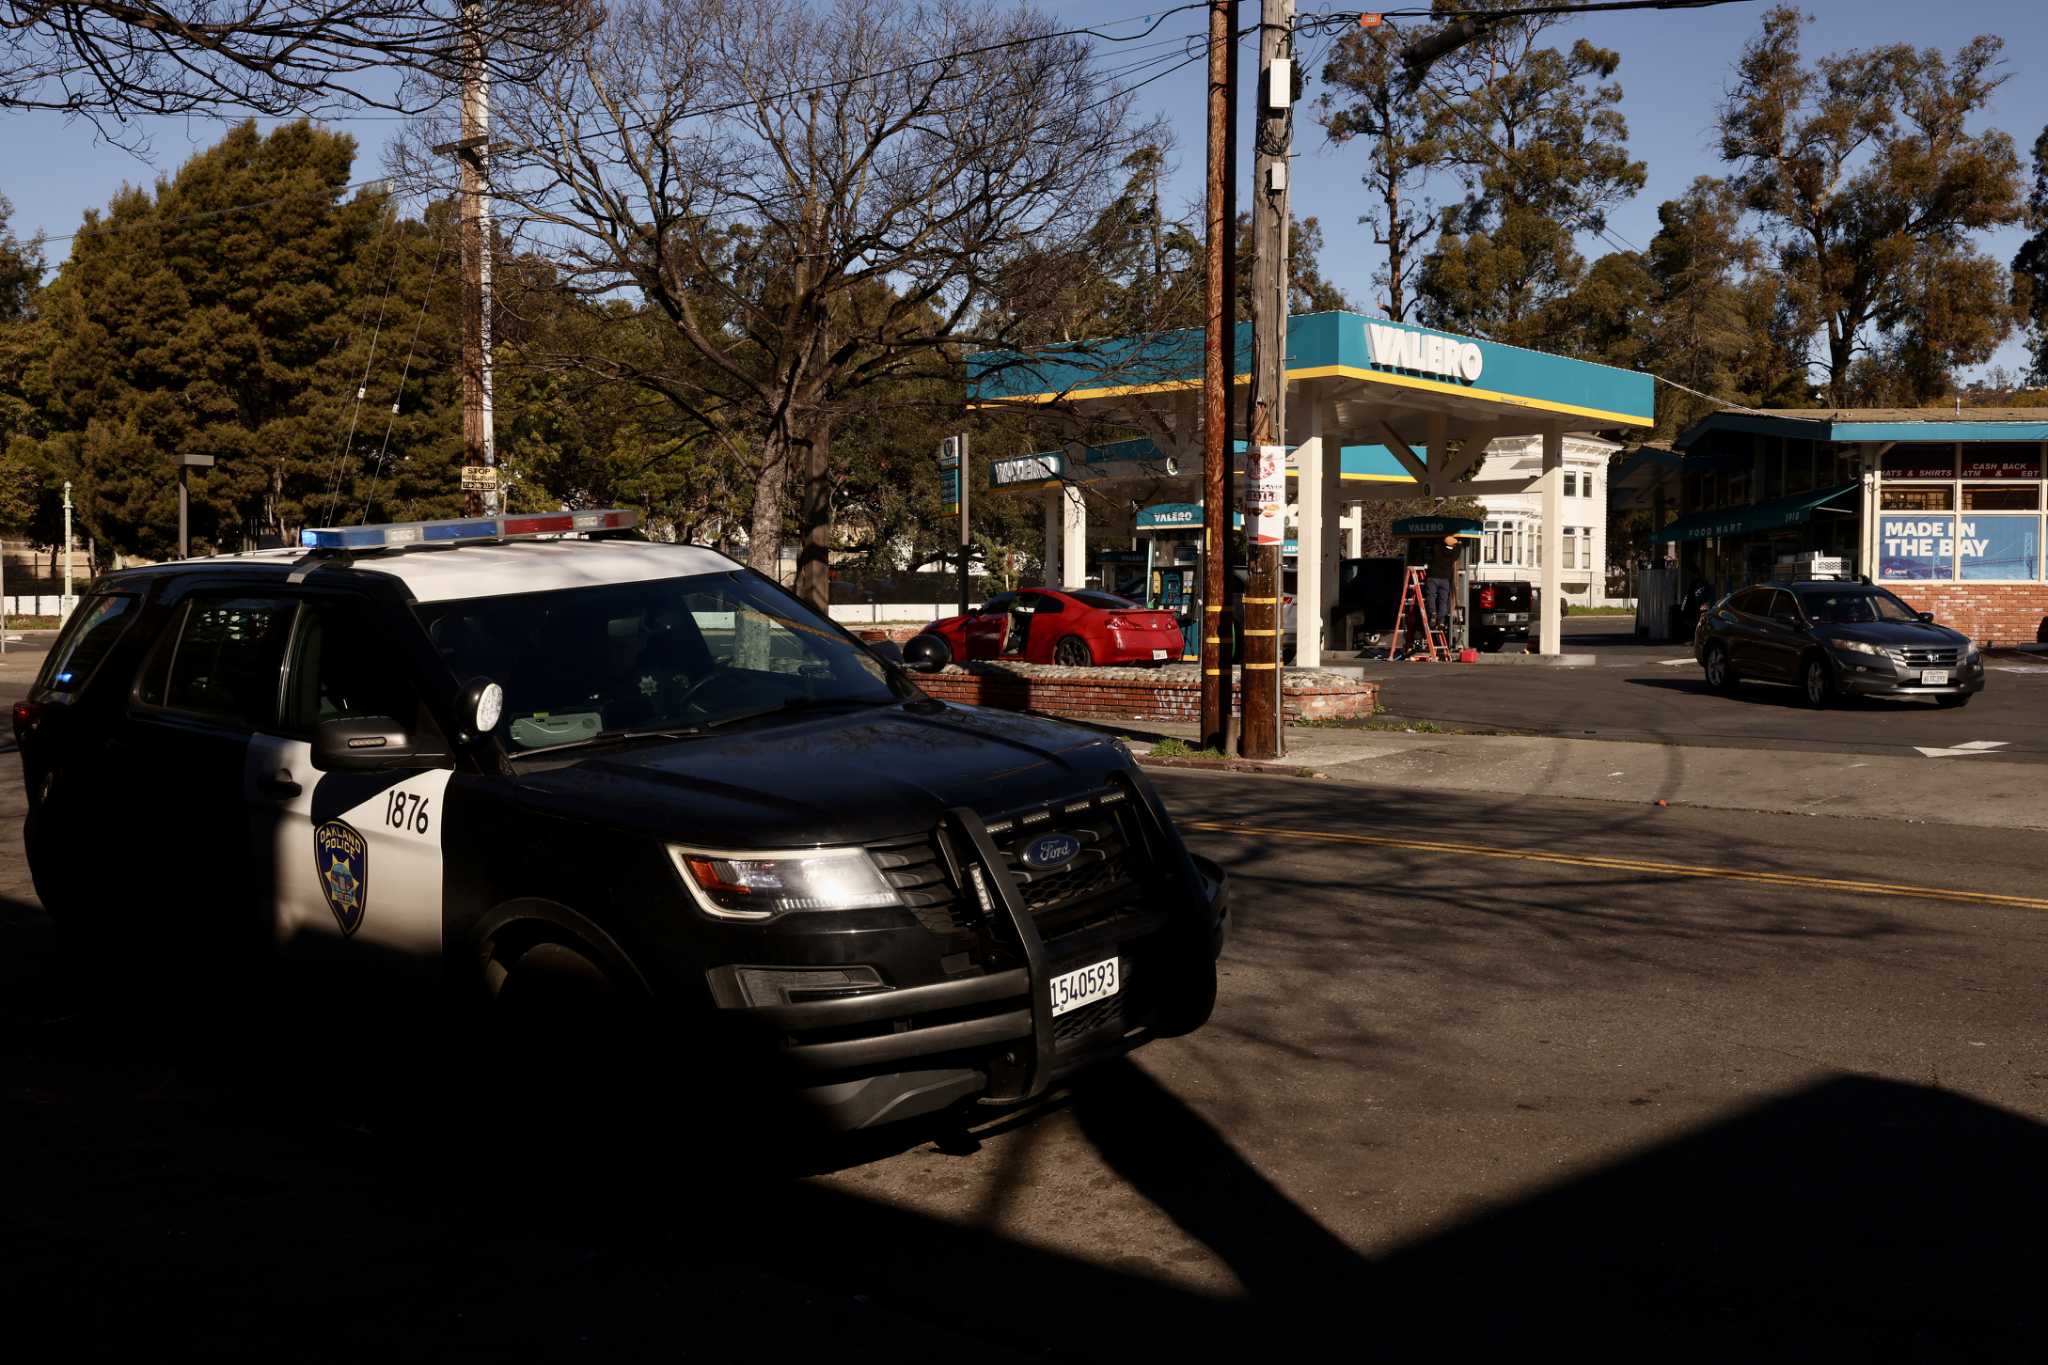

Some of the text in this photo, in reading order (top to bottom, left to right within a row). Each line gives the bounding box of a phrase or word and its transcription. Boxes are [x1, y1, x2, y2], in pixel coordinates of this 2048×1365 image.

[1364, 323, 1483, 381] VALERO
[995, 456, 1059, 484] VALERO
[1154, 511, 1193, 522] VALERO
[1408, 522, 1444, 532] VALERO
[1716, 522, 1743, 535] MART
[1885, 522, 1976, 537] MADE IN
[1885, 539, 1990, 557] THE BAY
[386, 789, 429, 834] 1876
[320, 827, 361, 854] OAKLAND
[325, 838, 356, 860] POLICE
[1040, 839, 1072, 861] Ford
[1051, 962, 1115, 1009] 1540593
